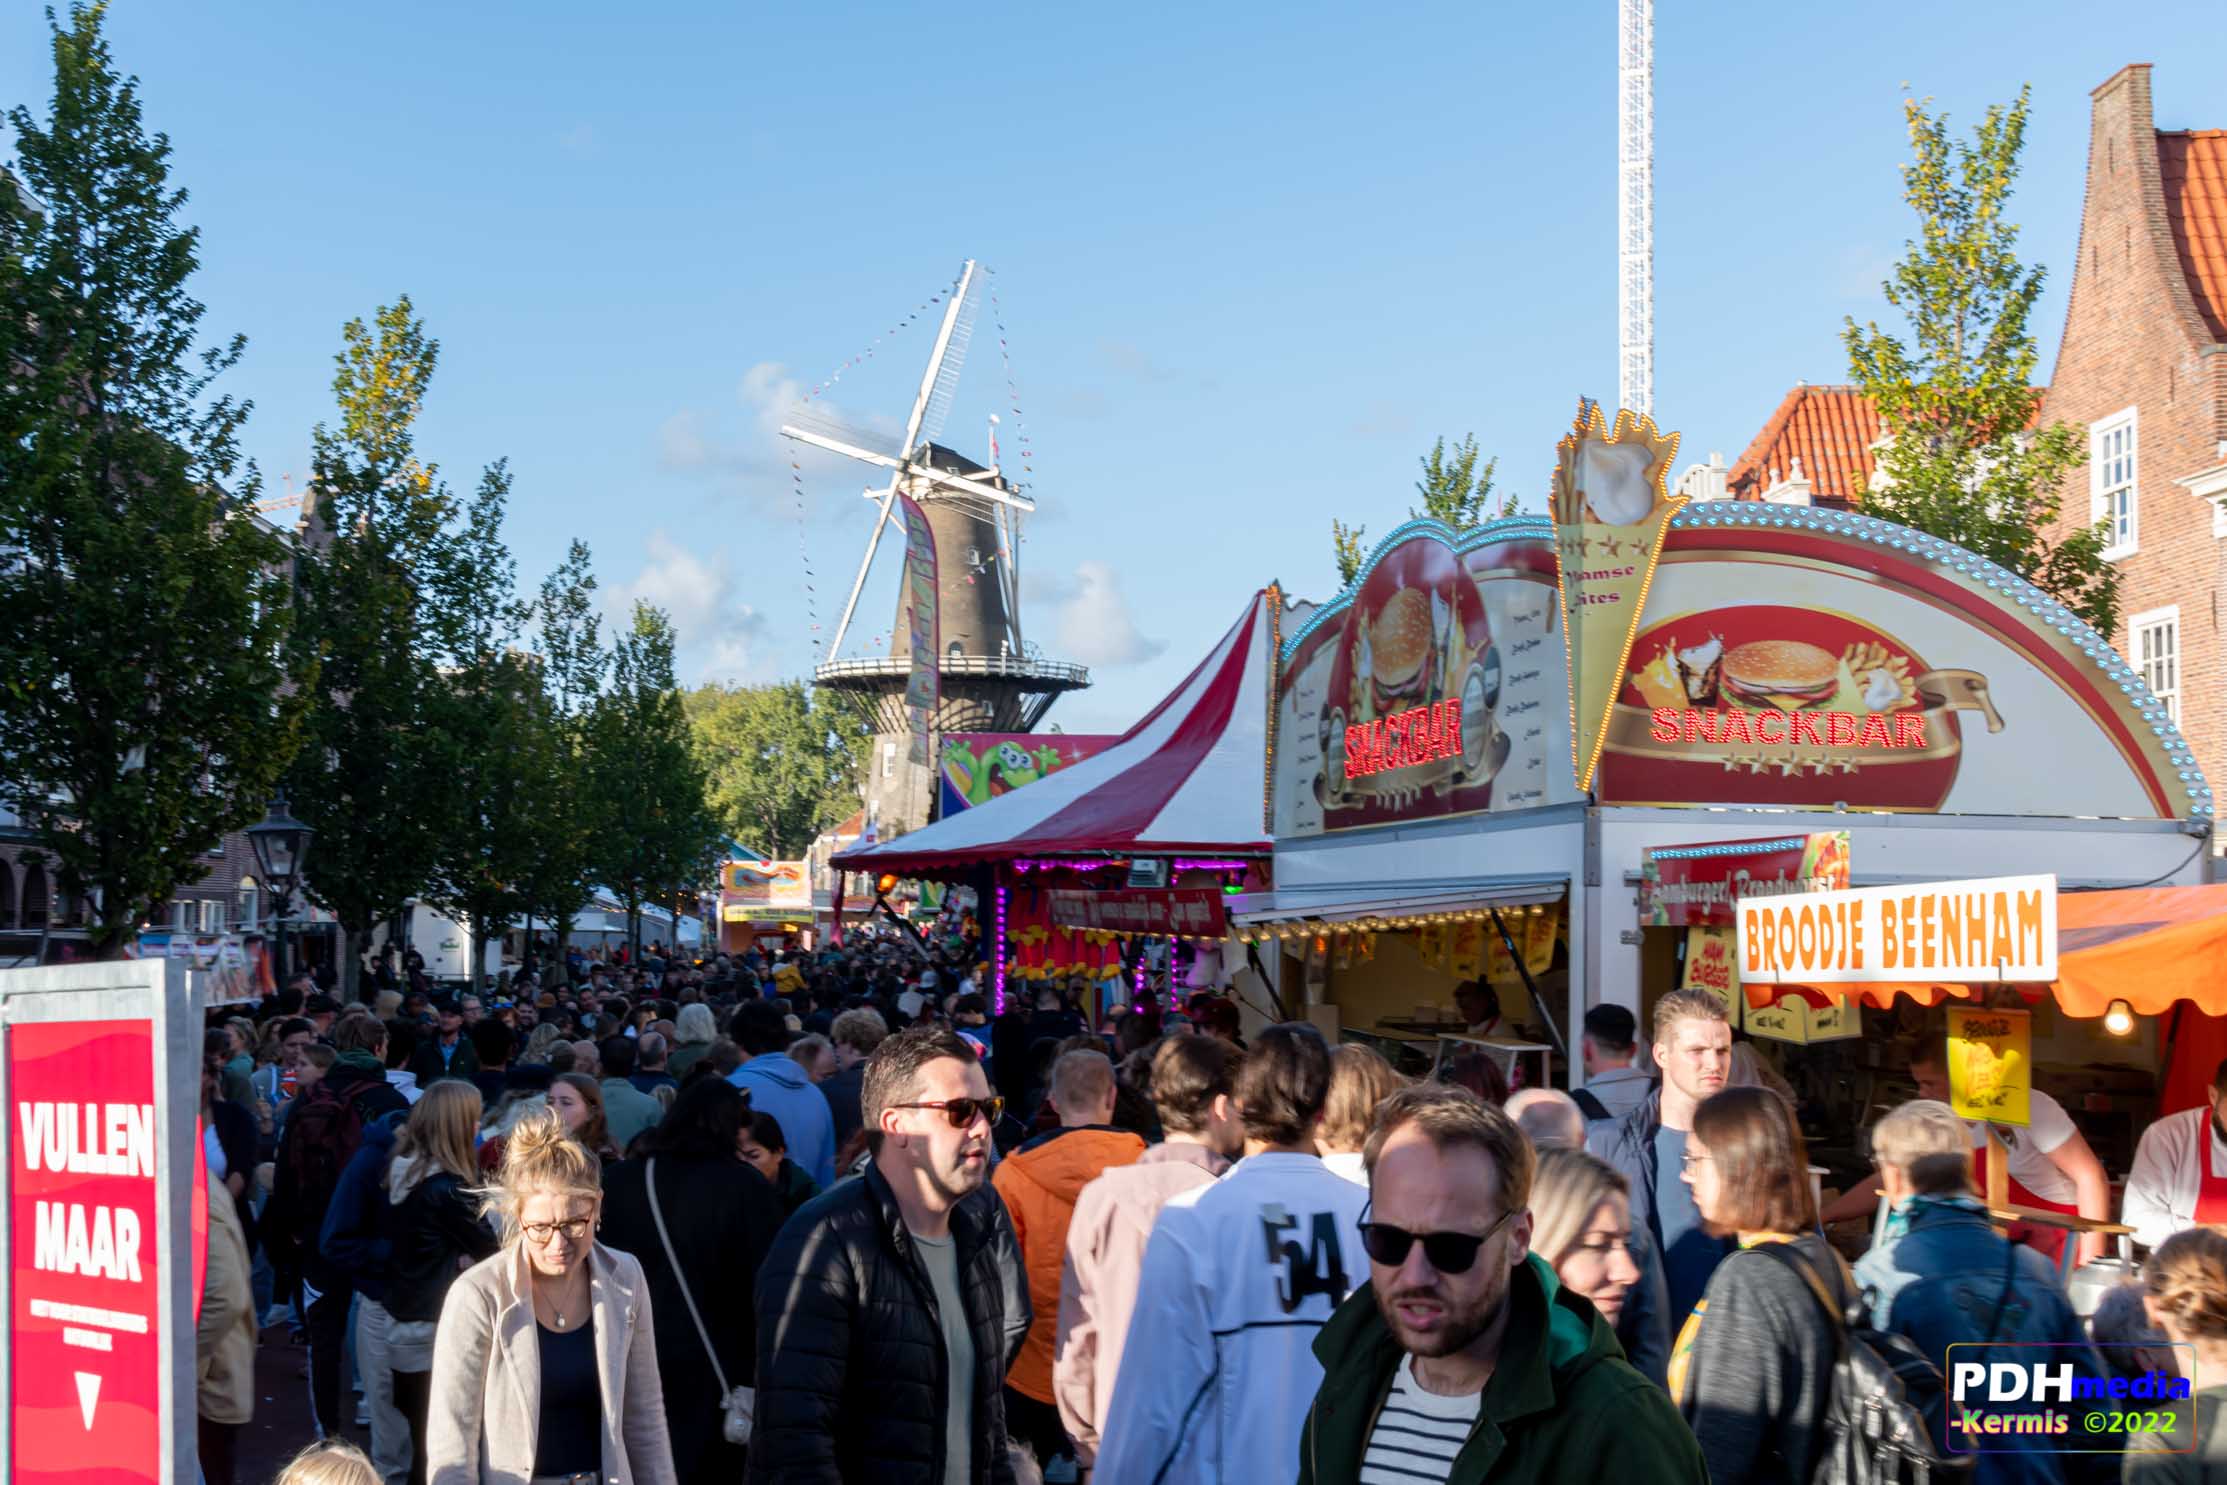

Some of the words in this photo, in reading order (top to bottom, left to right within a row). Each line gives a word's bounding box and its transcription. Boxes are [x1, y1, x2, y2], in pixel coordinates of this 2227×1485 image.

[1344, 697, 1464, 779] SNACKBAR
[1649, 706, 1929, 748] SNACKBAR
[1745, 899, 1865, 972] BROODJE
[1881, 889, 2045, 969] BEENHAM
[19, 1101, 155, 1178] VULLEN
[34, 1200, 143, 1282] MAAR
